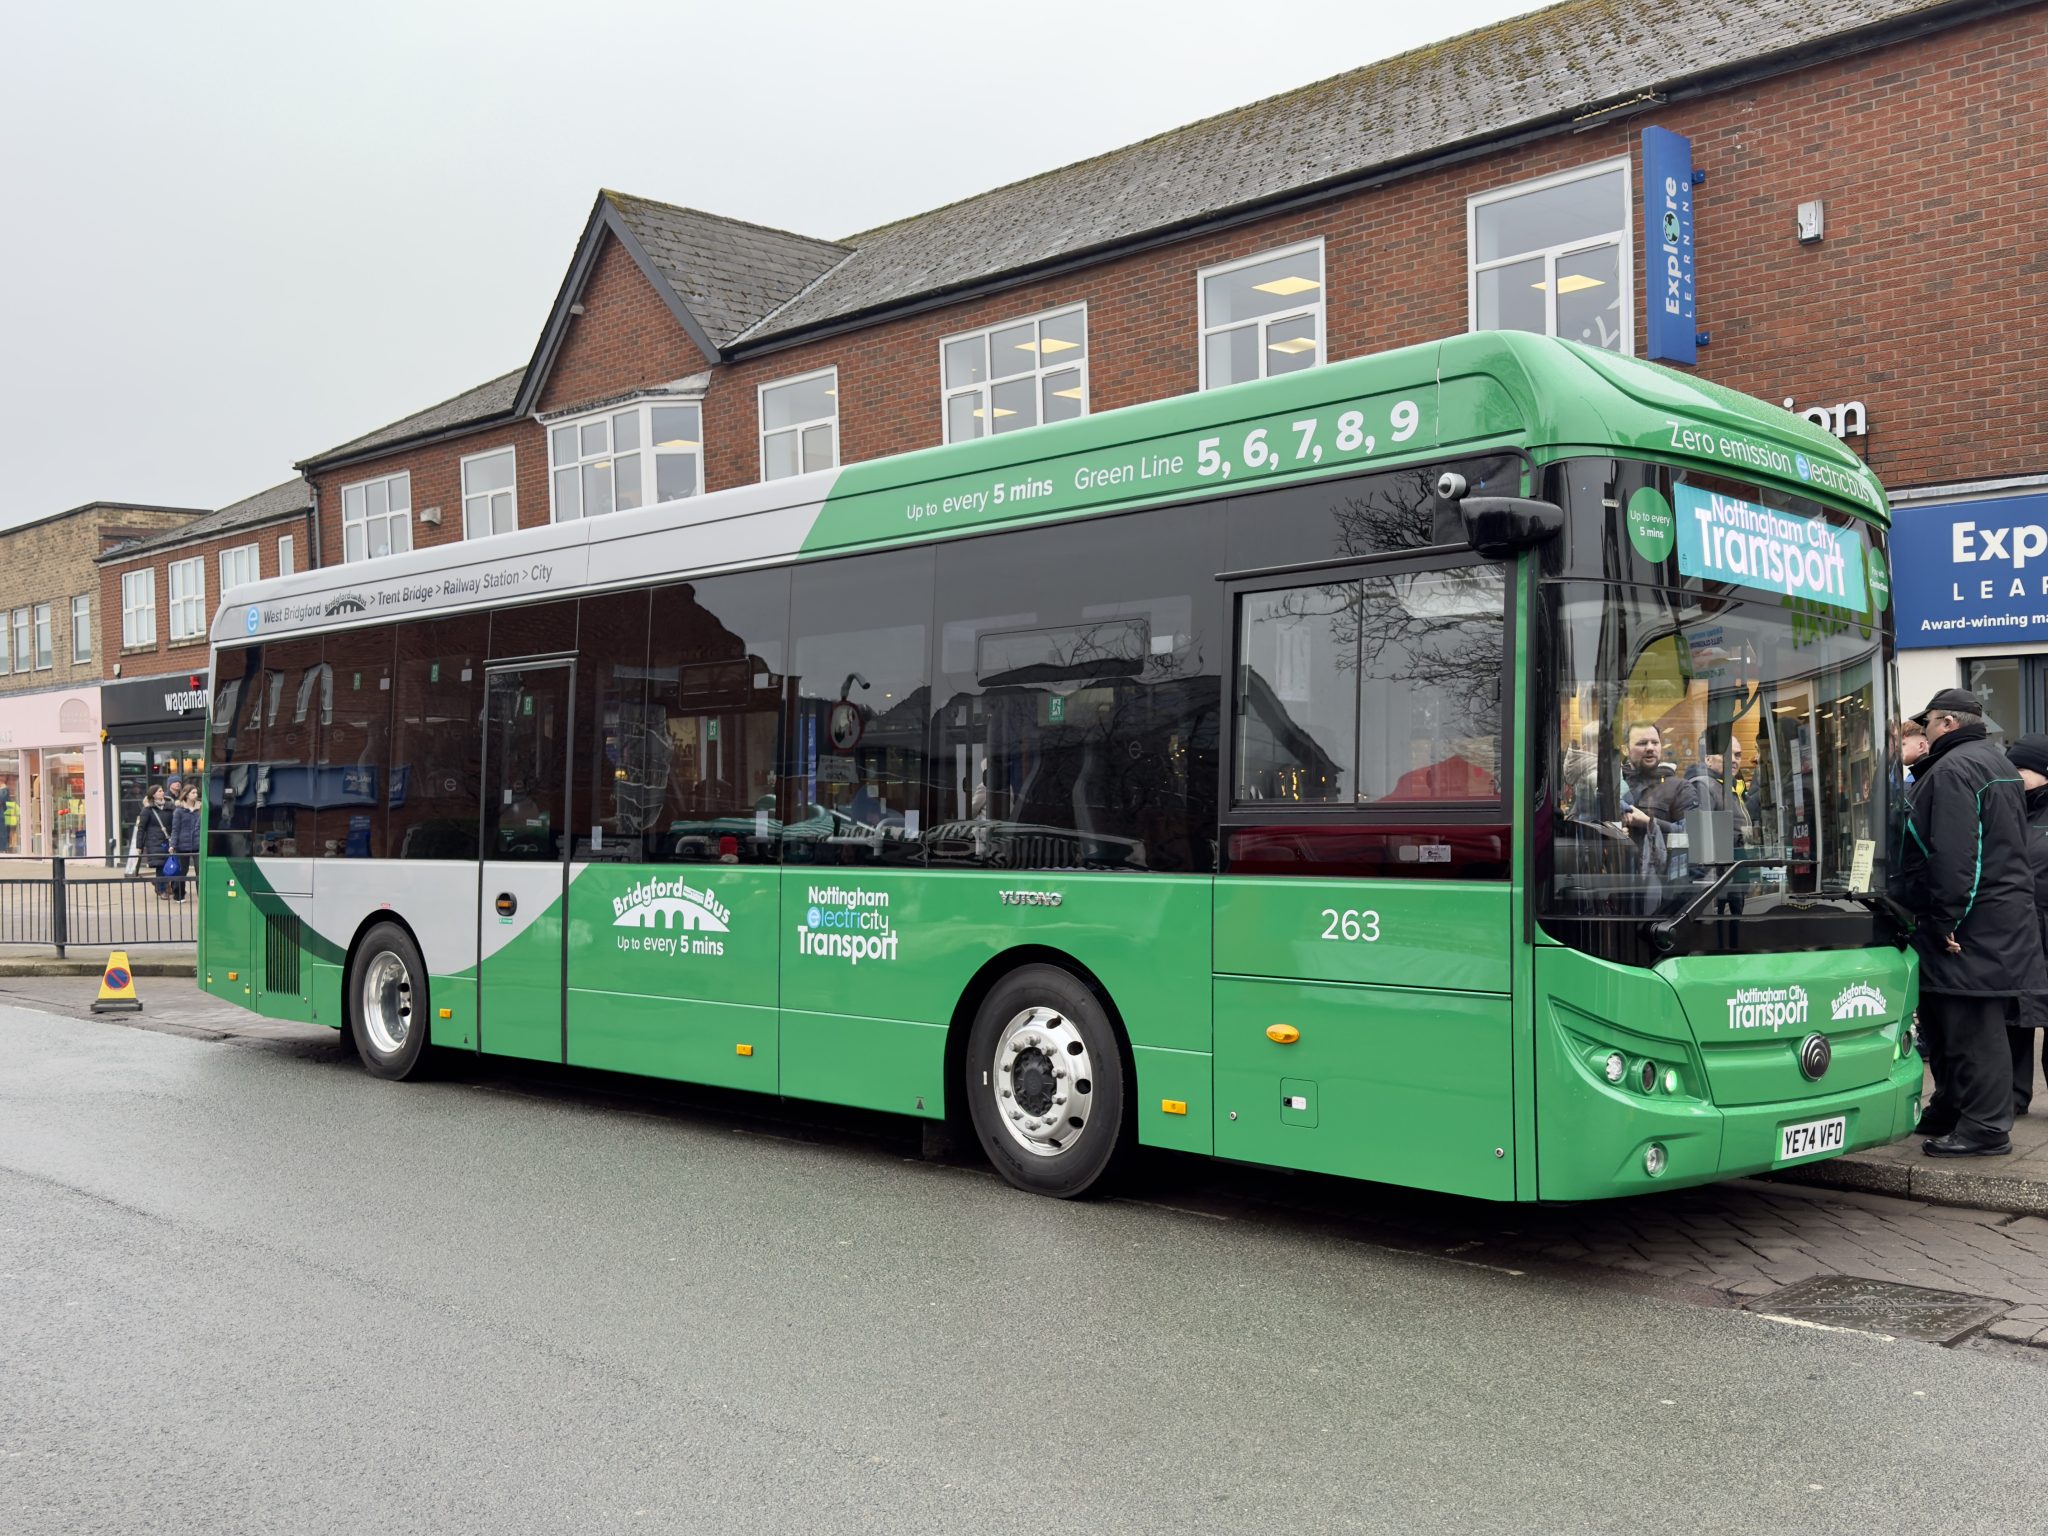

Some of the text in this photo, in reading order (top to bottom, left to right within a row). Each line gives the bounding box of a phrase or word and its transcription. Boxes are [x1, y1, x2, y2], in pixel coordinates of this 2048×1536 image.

[1682, 182, 1692, 318] LEARNING
[907, 400, 1419, 521] Up to every 5 mins Green Line 5, 6, 7, 8, 9
[1666, 420, 1715, 454] Zero
[1719, 437, 1792, 473] emission
[1630, 509, 1671, 527] Up to every
[1640, 526, 1664, 539] 5 mins
[1711, 494, 1836, 551] Nottingham City
[1694, 507, 1845, 597] Transport
[1952, 521, 2048, 569] Exp
[378, 565, 553, 606] Trent Bridge Railway Station City
[264, 608, 283, 624] West
[284, 603, 322, 622] Bridgford
[1920, 613, 2028, 631] Award-winning
[612, 875, 684, 917] Bridgford
[703, 888, 731, 924] Bus
[808, 886, 889, 910] Nottingham
[999, 890, 1063, 906] YUTONG
[1321, 908, 1380, 942] 263
[617, 934, 724, 957] Up to every 5 mins
[797, 925, 899, 965] Transport
[1736, 985, 1806, 1005] Nottingham City
[1831, 980, 1887, 1013] Bridgford Bus
[1727, 993, 1808, 1032] Transport
[1785, 1121, 1843, 1155] YE74 VFO
